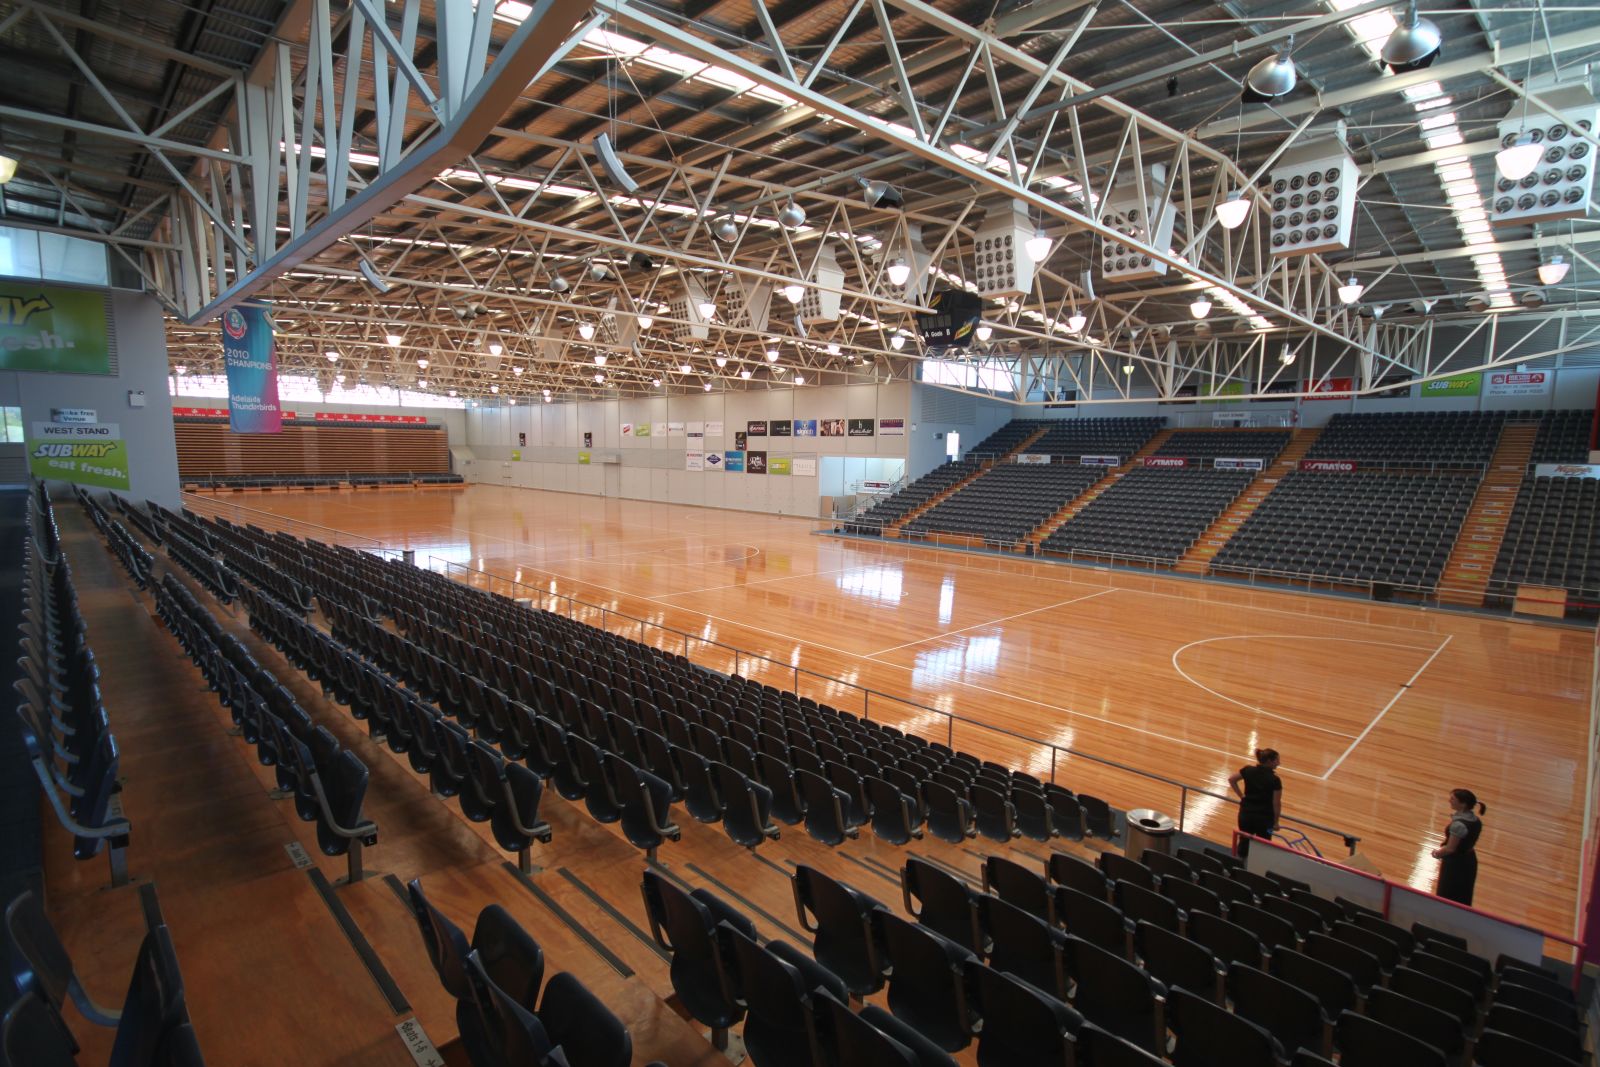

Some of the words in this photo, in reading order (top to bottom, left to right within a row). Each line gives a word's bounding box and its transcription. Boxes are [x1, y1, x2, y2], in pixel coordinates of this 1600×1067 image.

[227, 348, 249, 360] 2010
[1428, 379, 1473, 390] SUBWAY
[231, 401, 277, 411] Thunderbirds
[76, 427, 109, 435] STAND
[33, 442, 117, 458] SUBWAY
[48, 459, 76, 471] eat
[81, 462, 126, 479] fresh.
[1311, 462, 1353, 471] STRATCO
[402, 1022, 418, 1042] Seats
